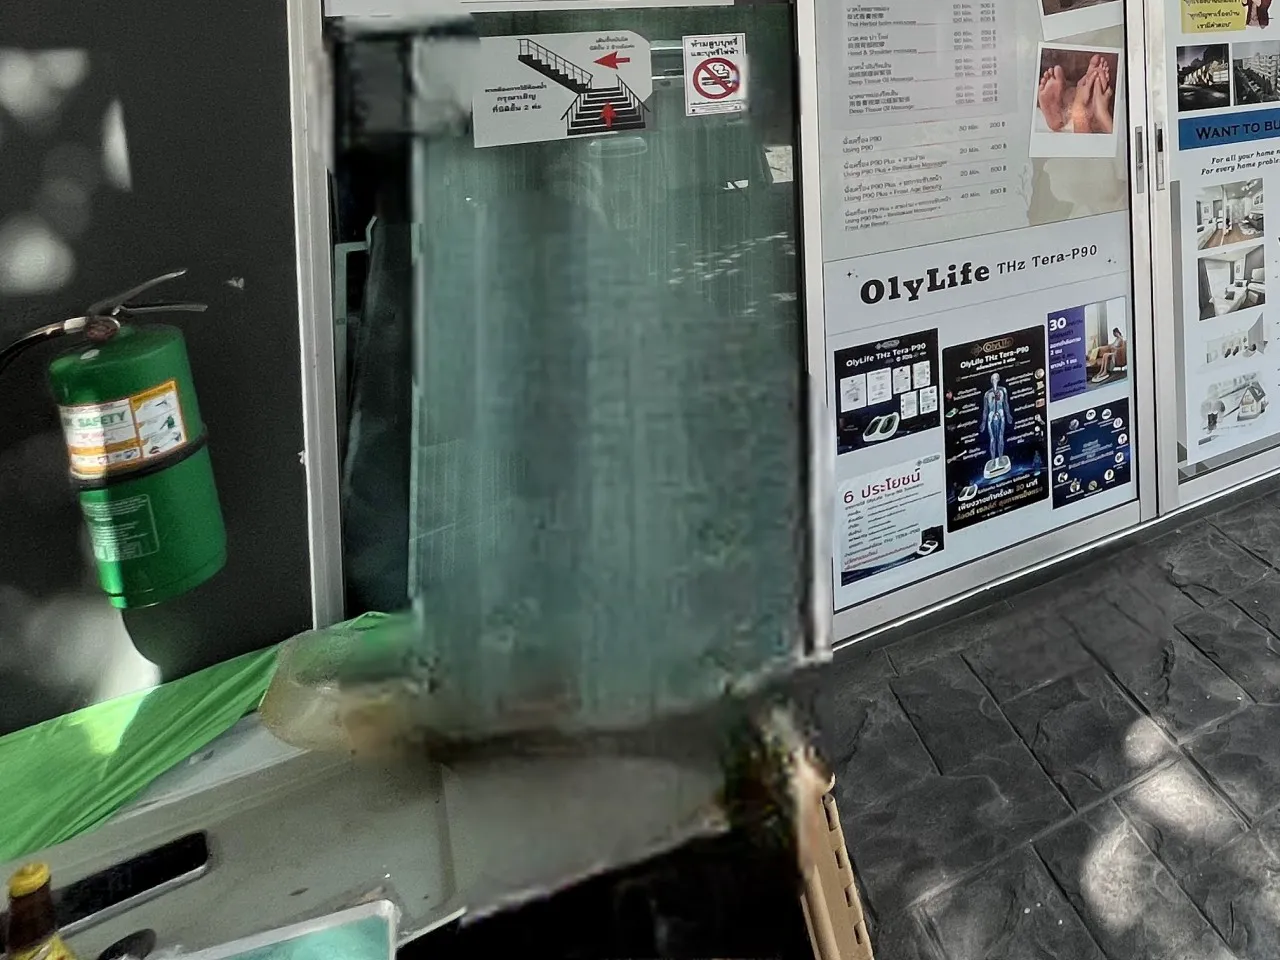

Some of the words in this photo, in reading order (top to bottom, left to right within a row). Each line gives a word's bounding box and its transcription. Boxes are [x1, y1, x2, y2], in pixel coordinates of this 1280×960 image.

[1243, 122, 1260, 134] TO
[1211, 156, 1224, 165] For
[1226, 154, 1237, 163] all
[1238, 152, 1254, 163] your
[1256, 149, 1275, 159] home
[1201, 168, 1214, 176] For
[1216, 163, 1235, 174] every
[1237, 161, 1256, 170] home
[859, 261, 991, 305] OlyLife
[996, 260, 1026, 275] THz
[1032, 244, 1098, 269] Tera-P90
[1049, 316, 1067, 332] 30
[846, 354, 874, 368] OlyLife
[77, 409, 126, 428] SAFETY
[843, 490, 854, 504] 6
[861, 465, 922, 499] ประโยชน์
